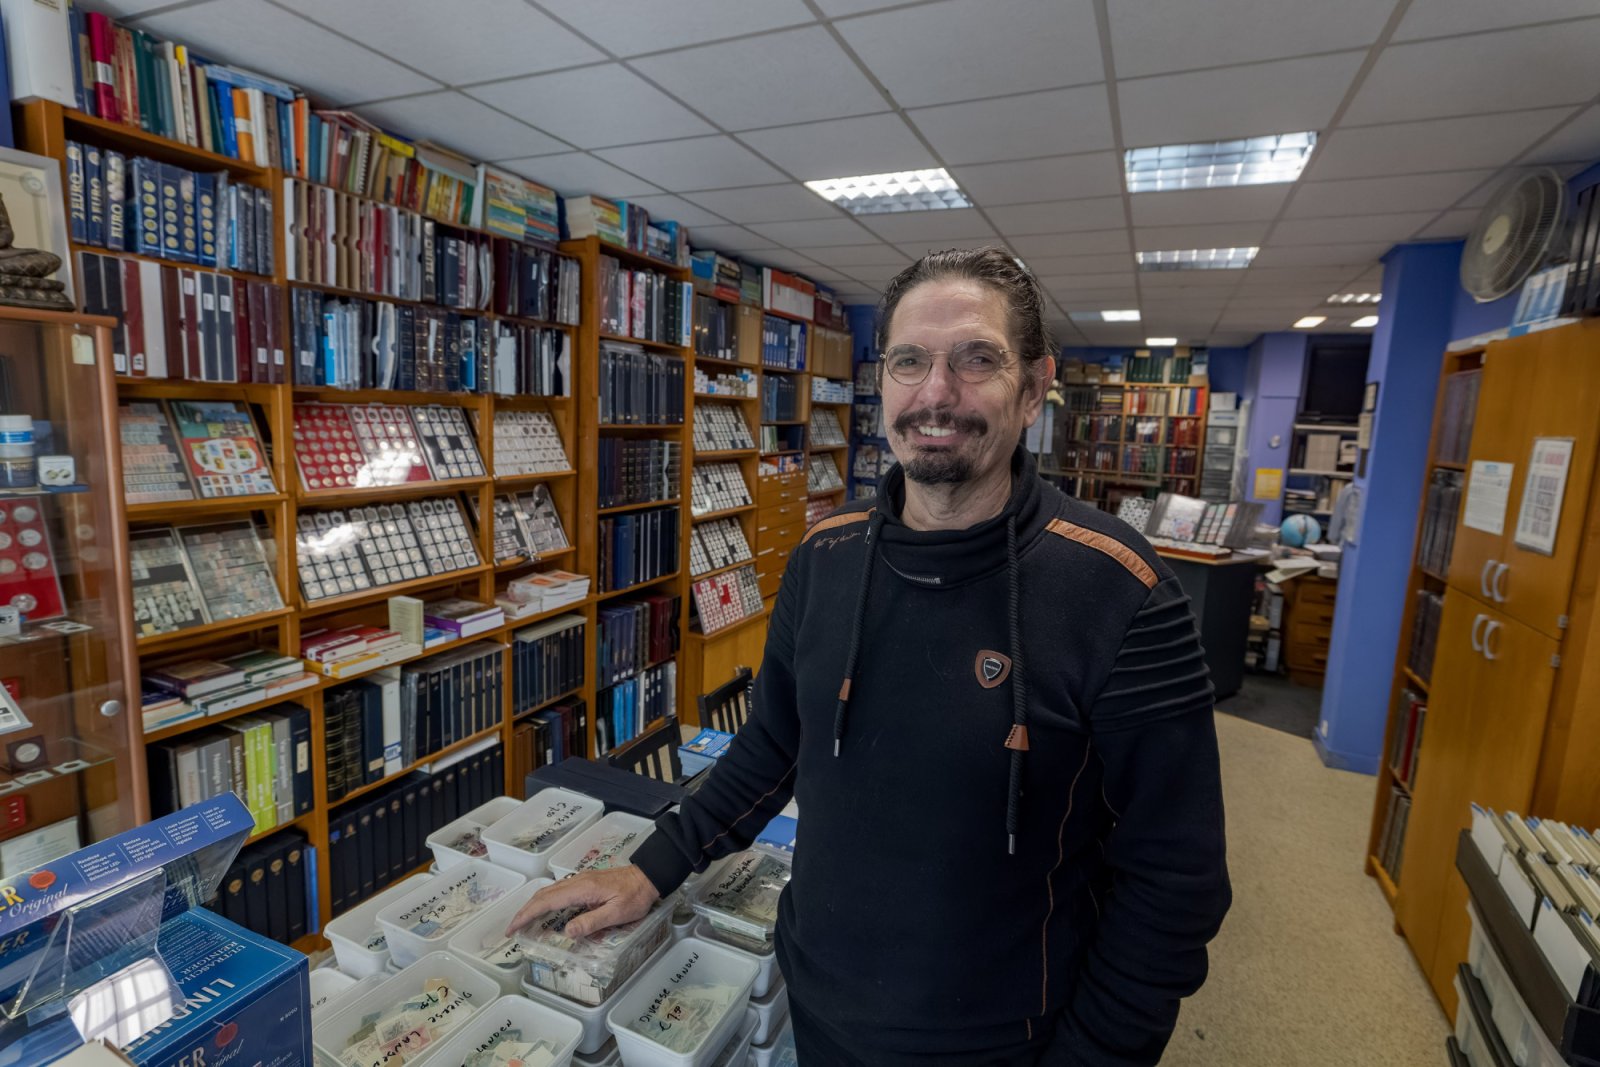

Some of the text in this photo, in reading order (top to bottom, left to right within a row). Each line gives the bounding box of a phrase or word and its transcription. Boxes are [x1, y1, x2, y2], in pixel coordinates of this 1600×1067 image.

[69, 173, 85, 212] EURO
[90, 176, 103, 214] EURO
[110, 203, 125, 239] EURO
[424, 238, 435, 274] EURO
[9, 883, 68, 917] Original
[399, 871, 477, 920] DIVERSE LANDEN
[177, 944, 247, 986] ULTRASCHA
[180, 940, 239, 975] REINIGER
[639, 951, 700, 1023] DIVERSE LANDEN
[428, 991, 473, 1023] DIVERSE
[373, 1030, 421, 1067] LANDEN
[476, 1019, 512, 1053] LANDEN
